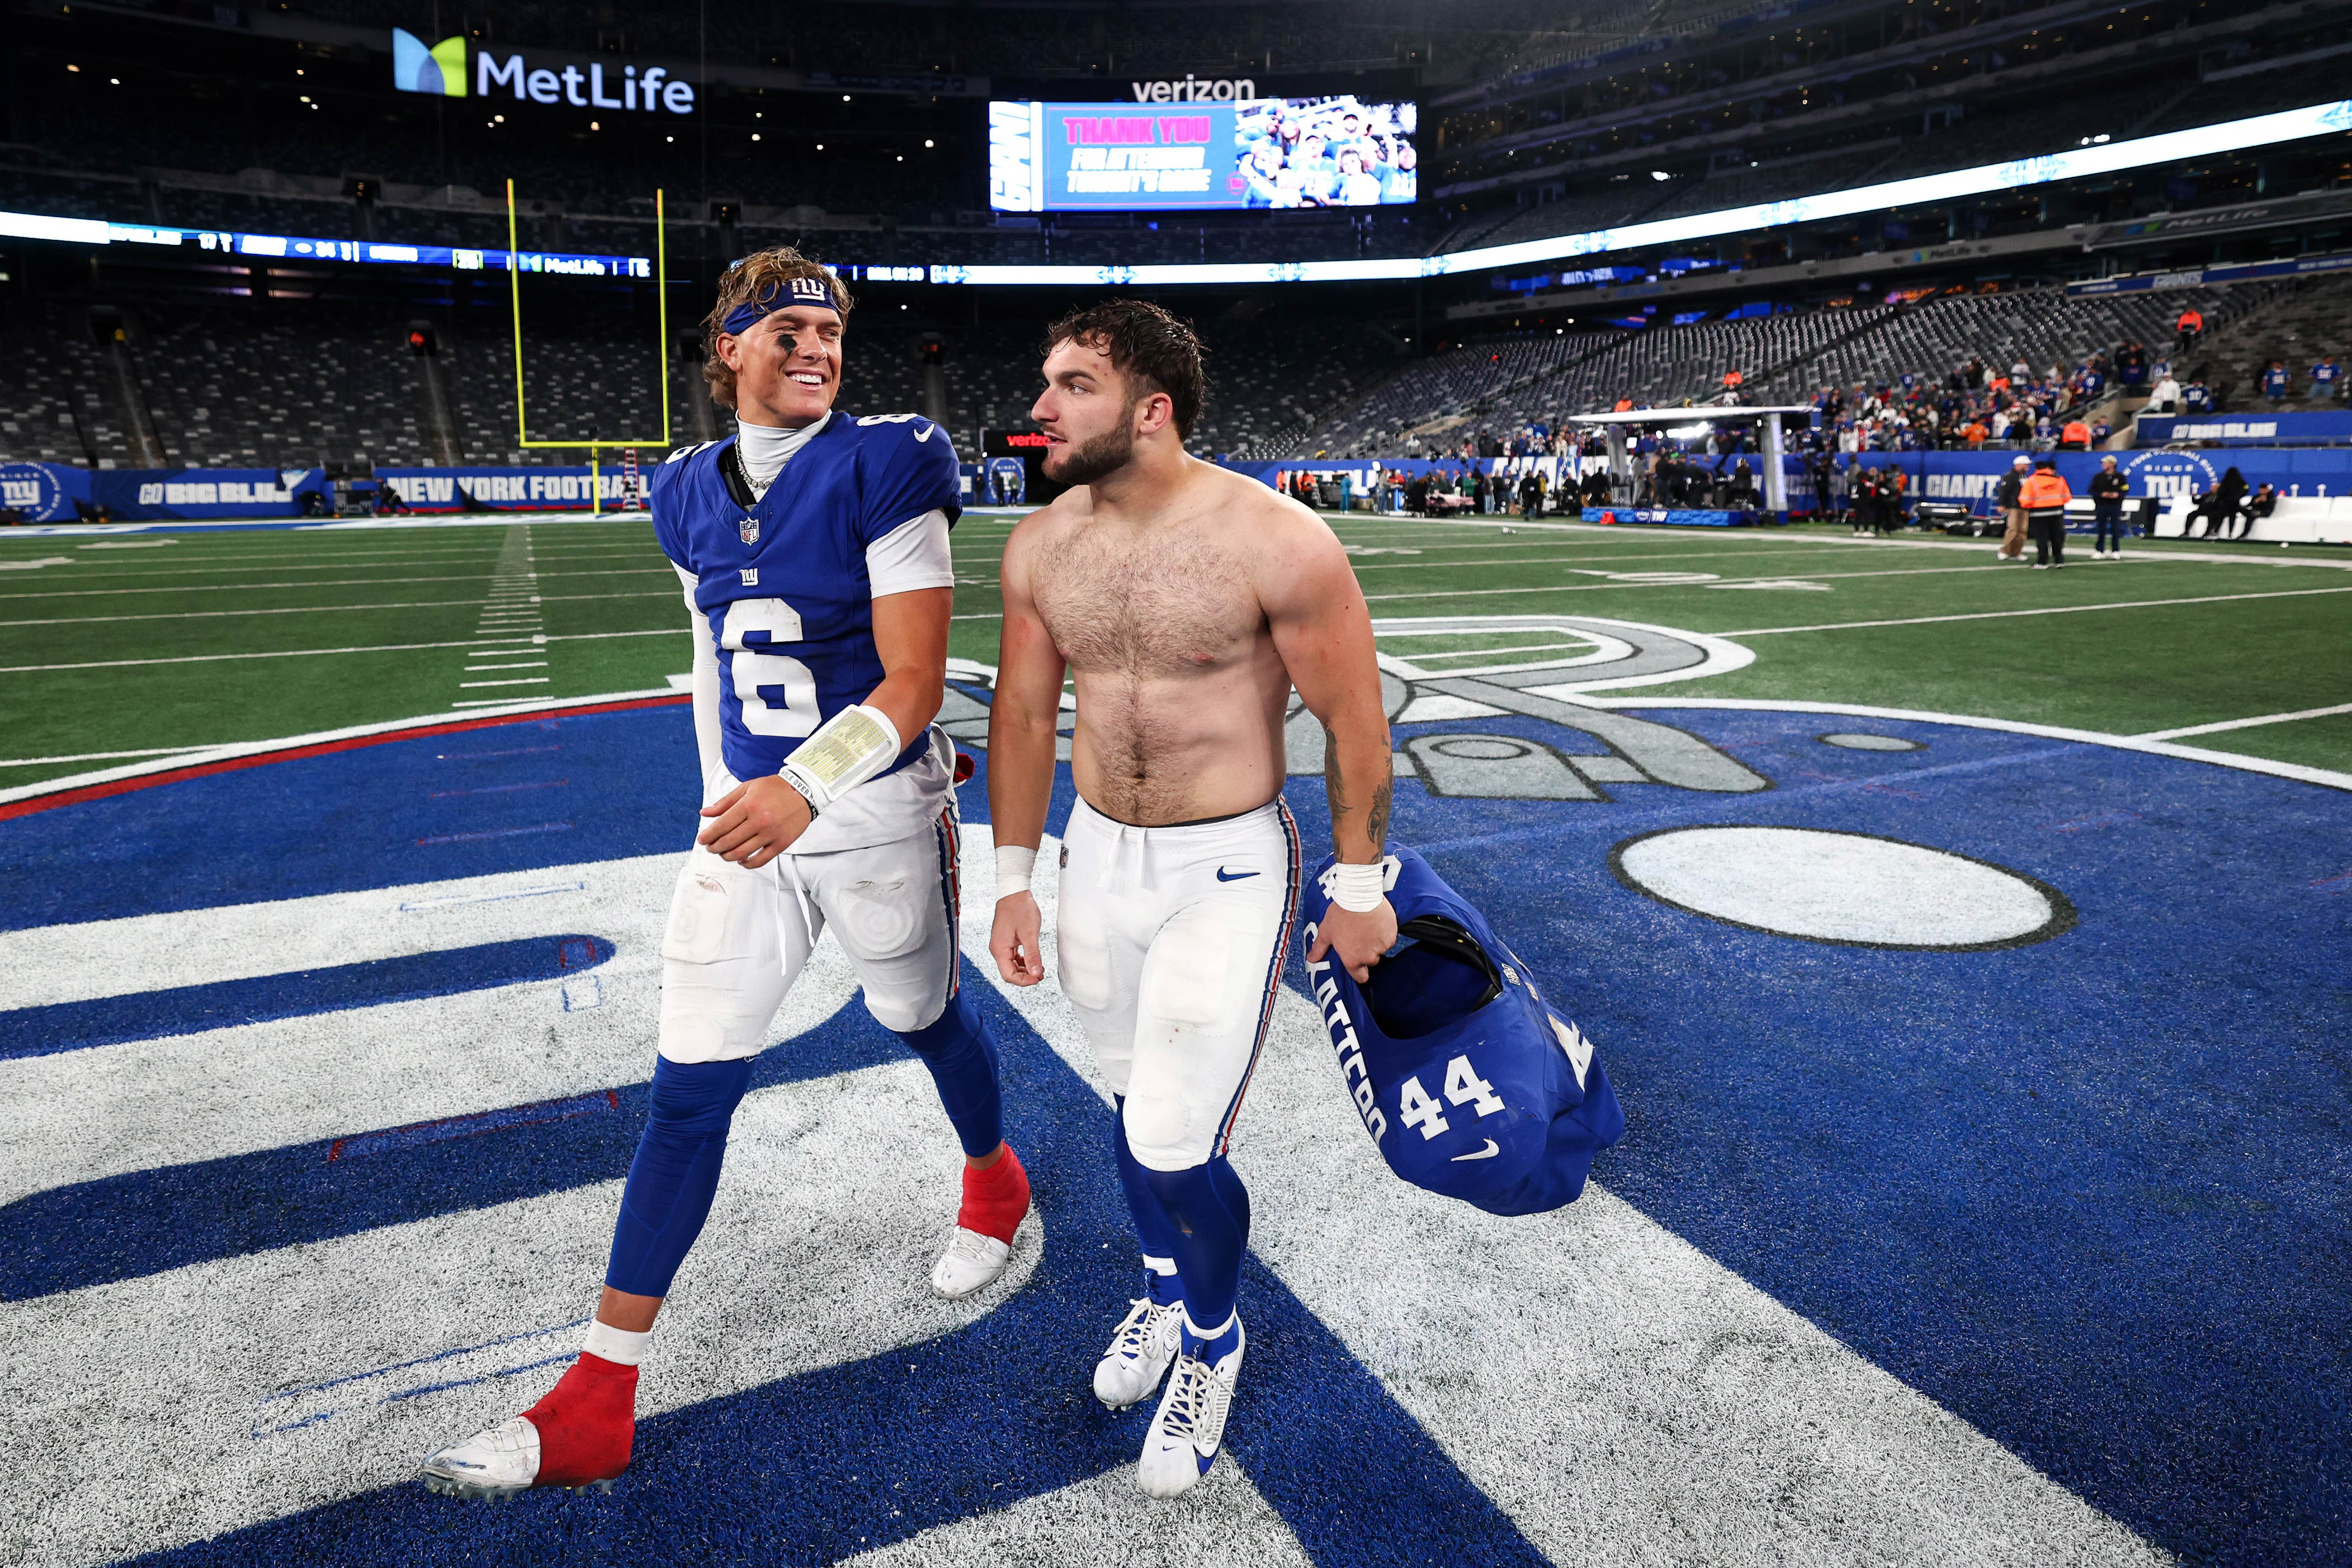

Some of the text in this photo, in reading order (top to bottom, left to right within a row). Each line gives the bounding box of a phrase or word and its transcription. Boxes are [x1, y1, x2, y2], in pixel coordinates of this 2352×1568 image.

[477, 51, 694, 114] MetLife
[1132, 73, 1255, 102] verizon
[1063, 116, 1210, 144] THANK YOU
[164, 483, 217, 504] BIG
[386, 476, 453, 503] NEW
[456, 475, 527, 502] YORK
[1925, 474, 2002, 498] GIANT
[743, 530, 757, 540] NFL
[720, 597, 823, 738] 6
[794, 780, 809, 795] OVER
[1400, 1054, 1506, 1141] 44
